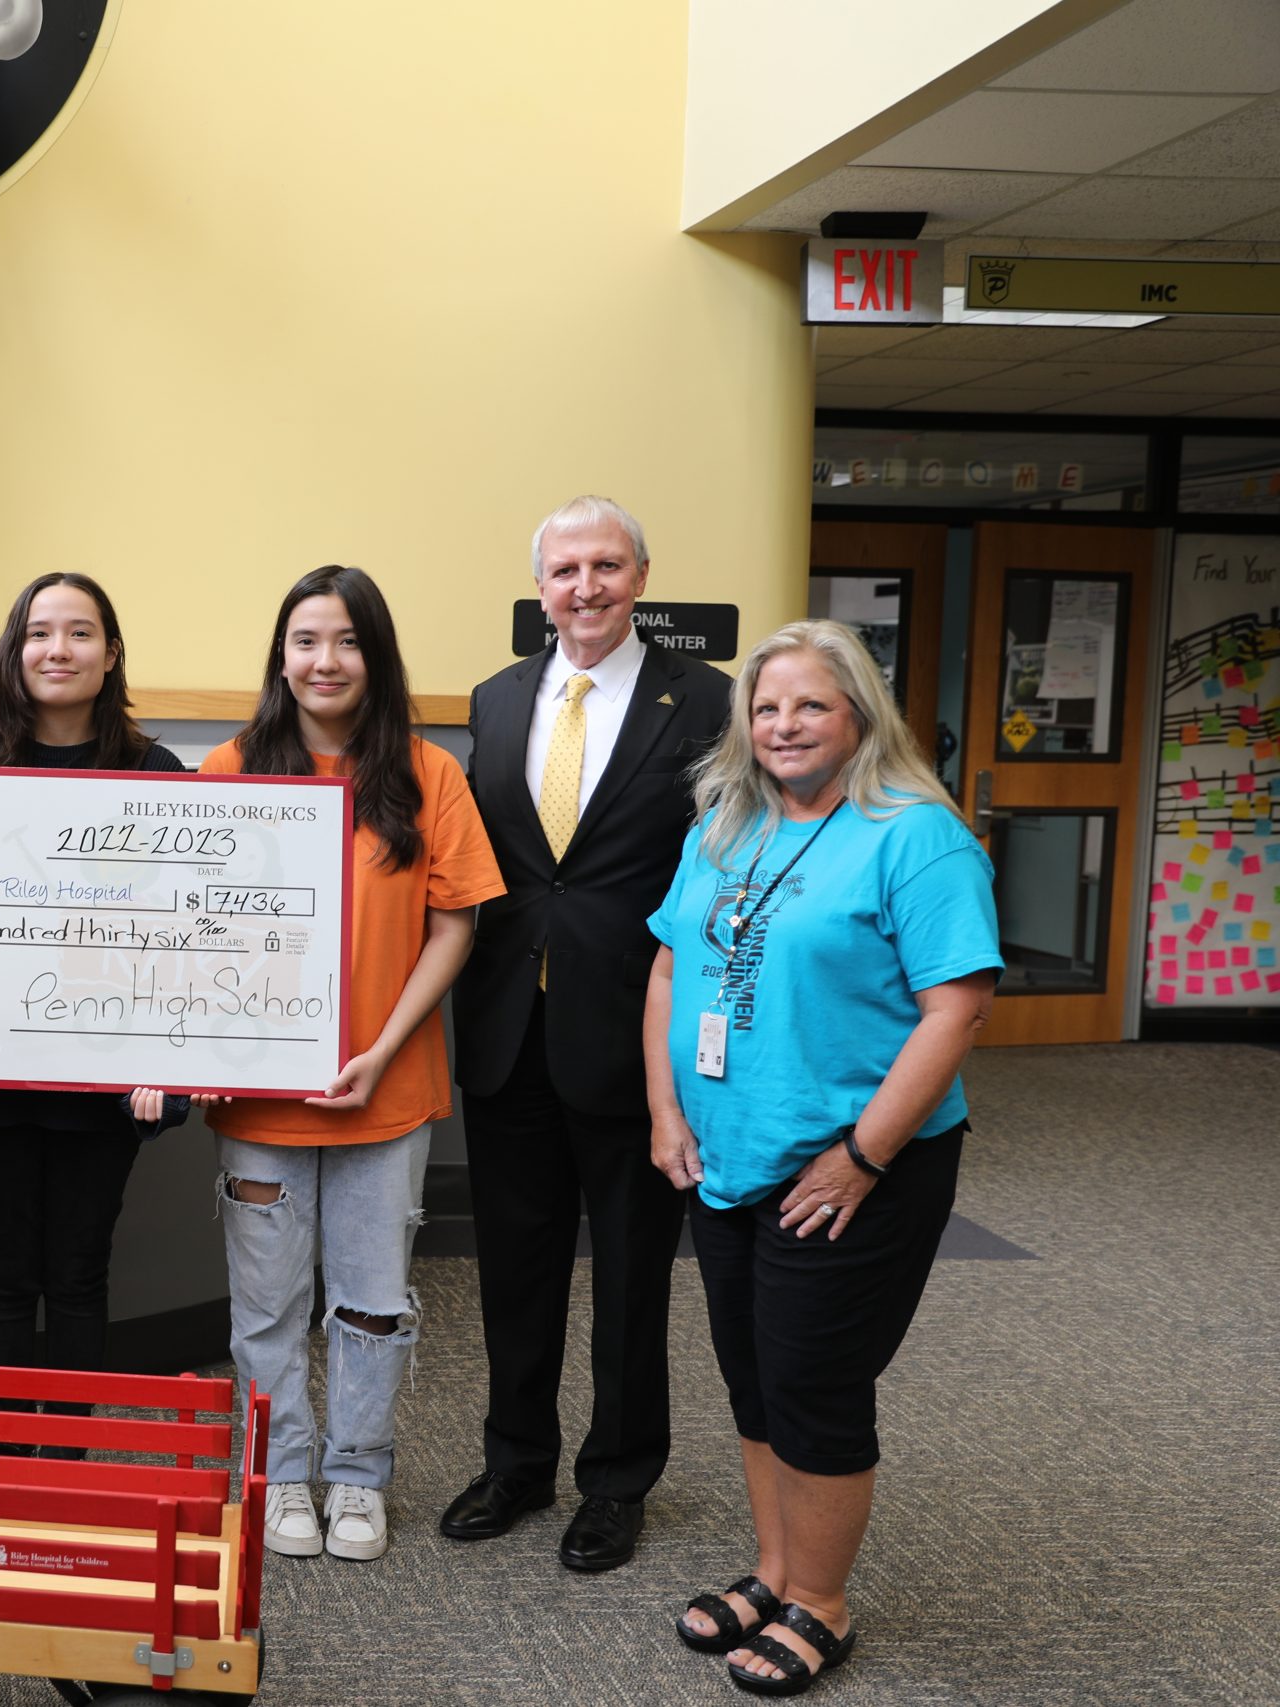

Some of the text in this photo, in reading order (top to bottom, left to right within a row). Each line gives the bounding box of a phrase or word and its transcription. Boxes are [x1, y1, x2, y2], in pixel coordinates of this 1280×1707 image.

[833, 249, 918, 312] EXIT
[1141, 284, 1178, 302] IMC
[1193, 553, 1277, 584] Find Your
[654, 635, 707, 650] ENTER
[122, 800, 319, 824] RILEYKIDS.ORG/KCS
[56, 823, 238, 857] 2022-2023
[197, 867, 224, 877] DATE
[55, 879, 134, 907] Hospital
[186, 890, 201, 911] $
[73, 916, 151, 954] thirty
[154, 926, 193, 950] six
[198, 937, 245, 947] DOLLARS
[733, 914, 773, 1031] KINGSMEN
[20, 963, 335, 1048] Penn High School
[10, 1551, 109, 1566] Riley Hospital for Children
